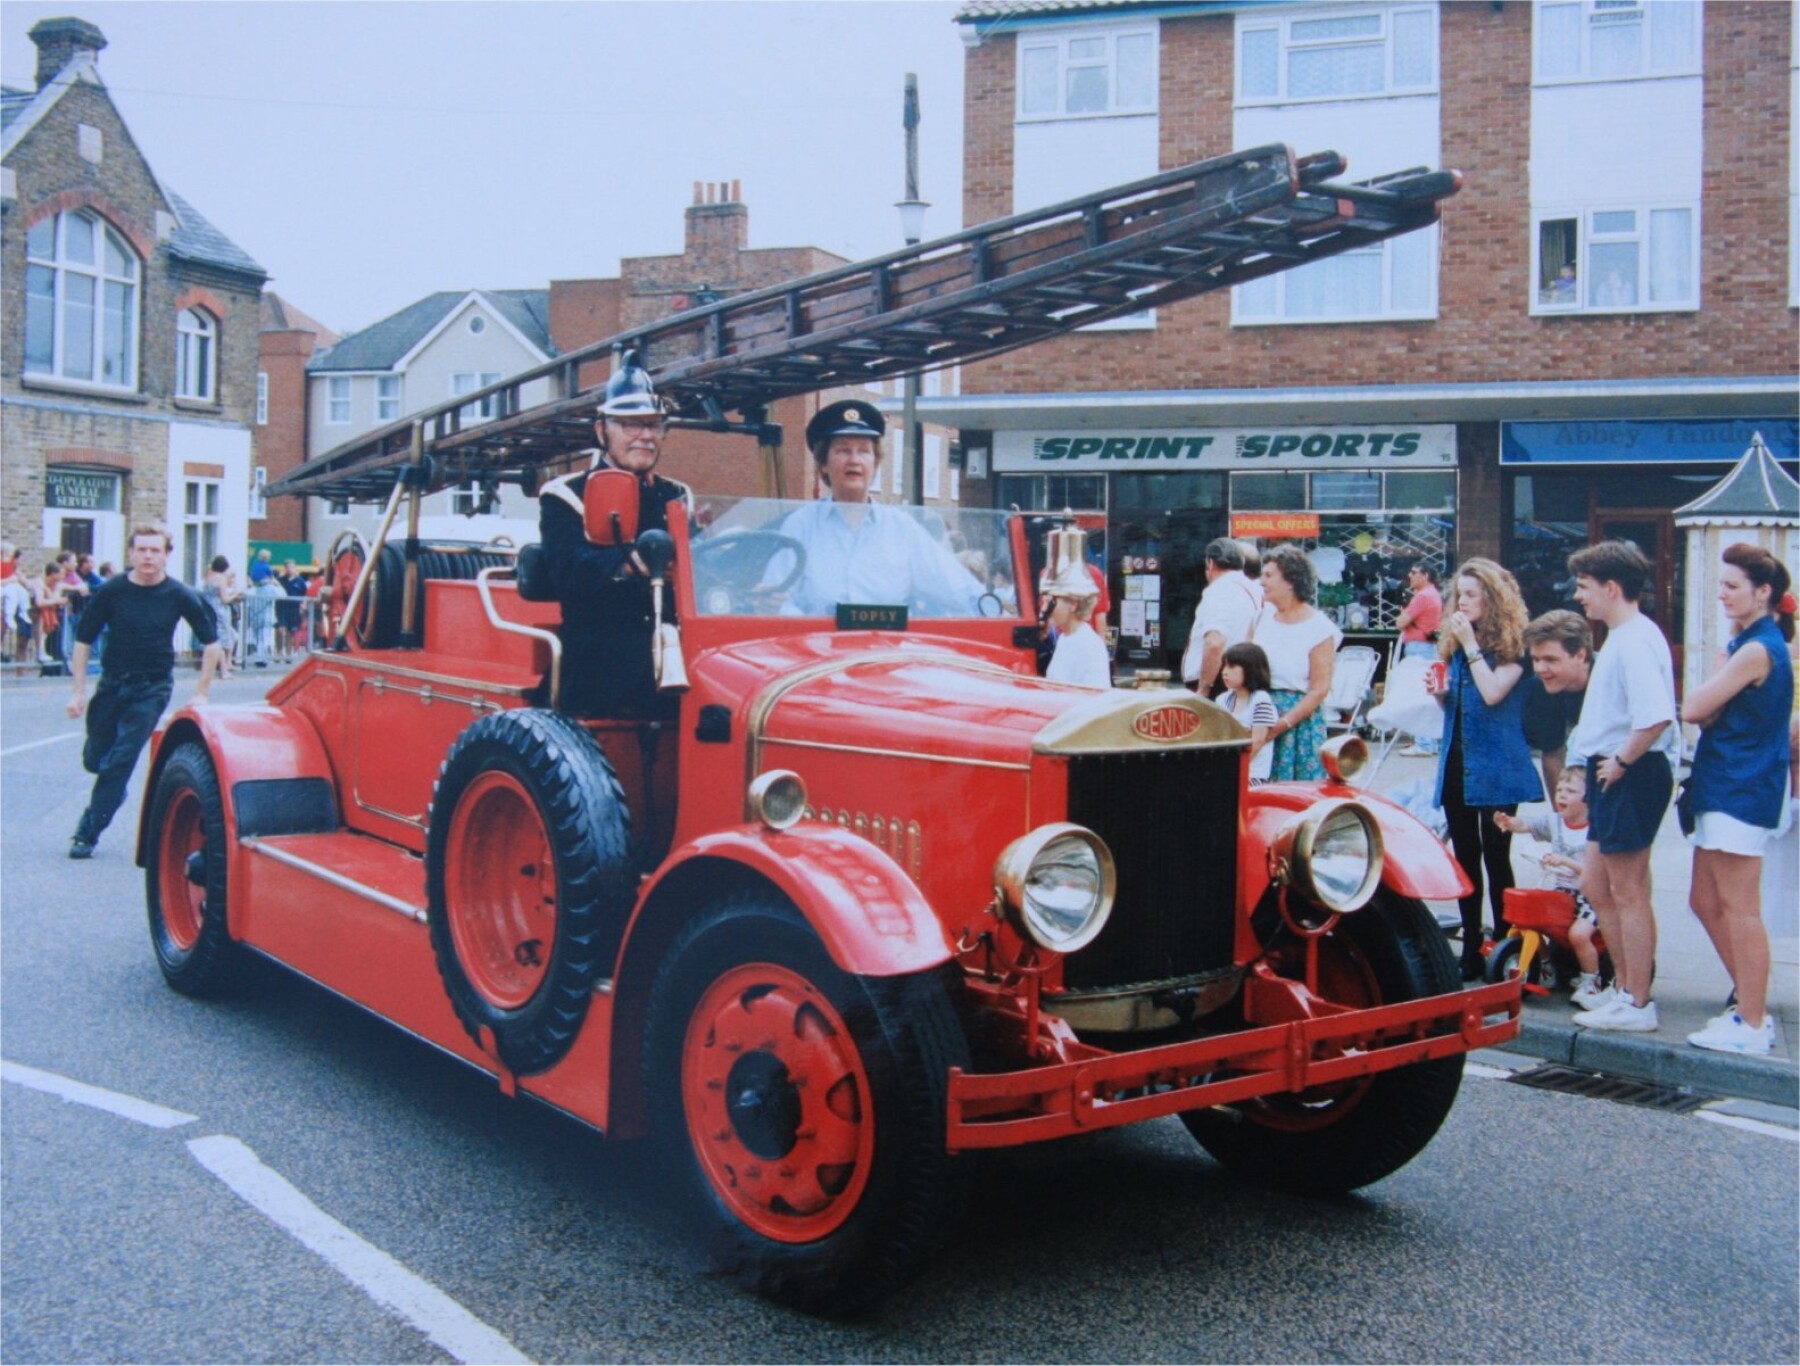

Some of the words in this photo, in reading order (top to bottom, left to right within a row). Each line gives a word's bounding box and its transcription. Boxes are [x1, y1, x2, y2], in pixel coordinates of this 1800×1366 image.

[1554, 422, 1641, 448] Abbey
[1036, 436, 1215, 461] SPRINT
[1239, 432, 1422, 459] SPORTS
[46, 474, 112, 489] O-OPERATIVE
[54, 484, 100, 498] FUNERAL
[56, 496, 98, 508] SERVICE
[1235, 519, 1273, 530] SPECIAL
[1277, 519, 1317, 530] OFFERS
[850, 609, 897, 622] TOPSY
[1139, 707, 1197, 738] DENNIS
